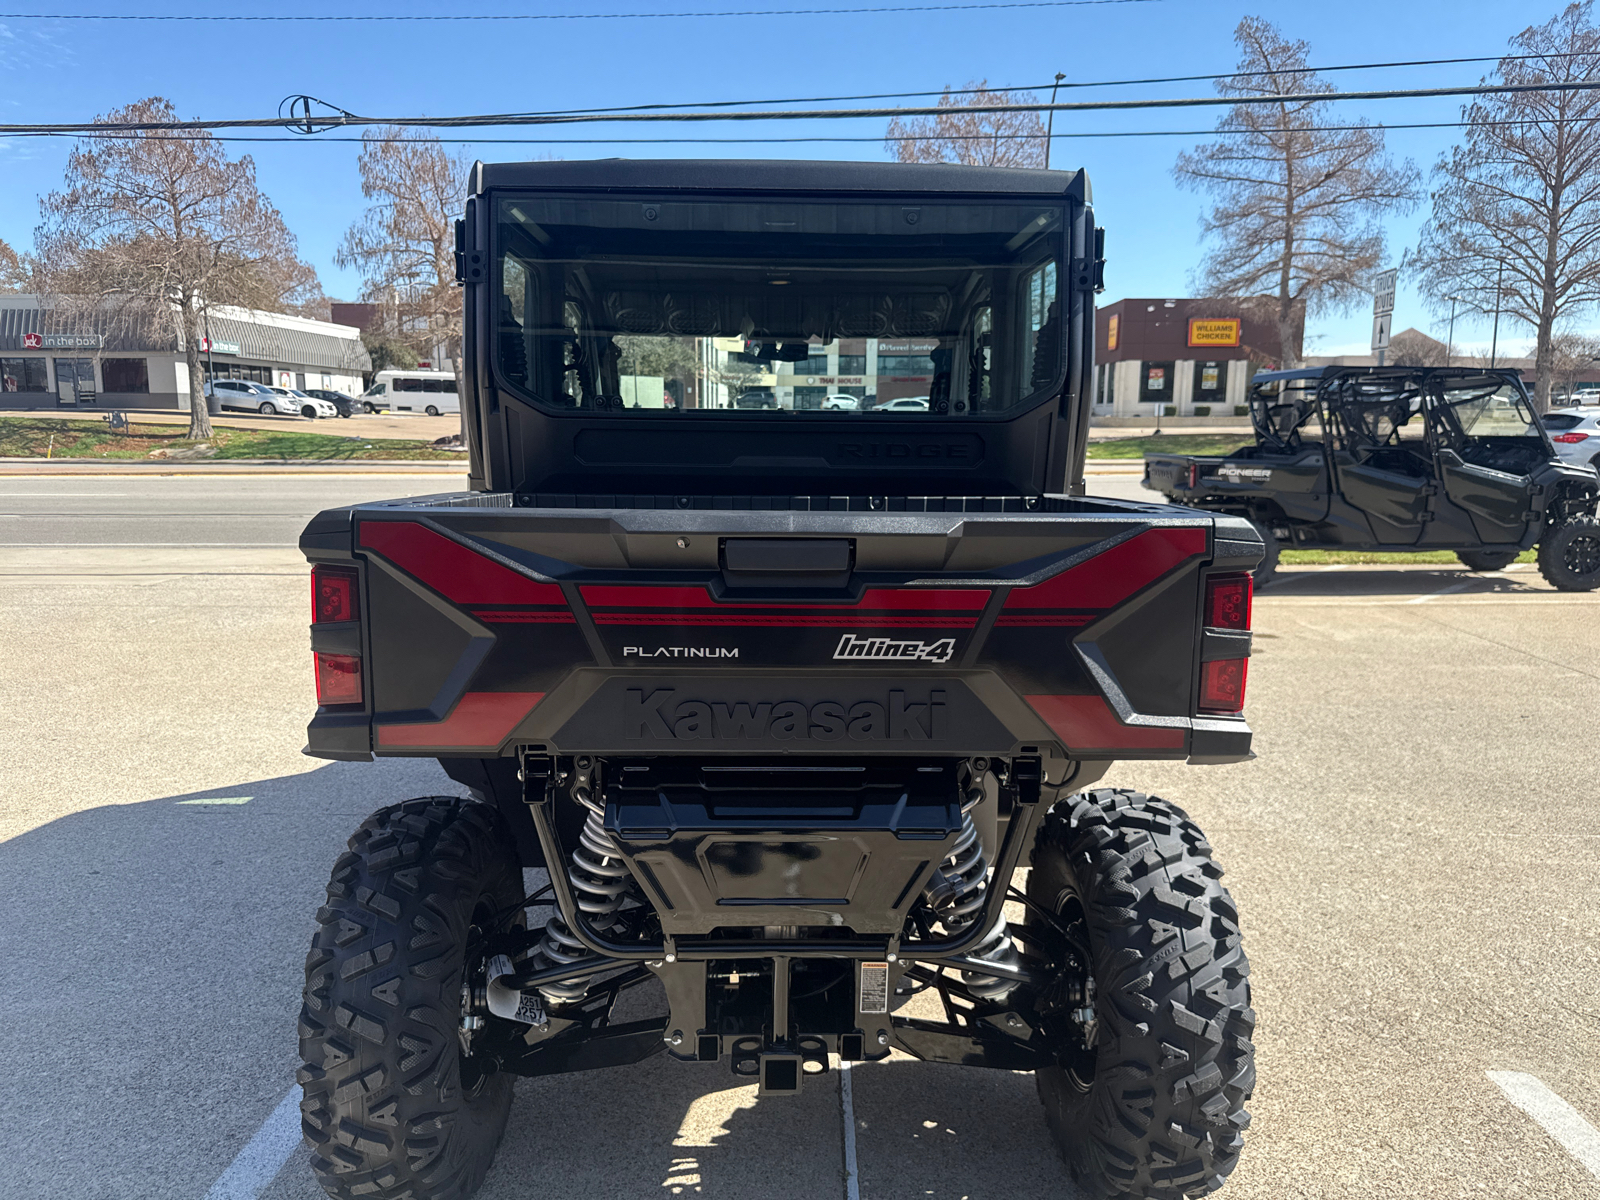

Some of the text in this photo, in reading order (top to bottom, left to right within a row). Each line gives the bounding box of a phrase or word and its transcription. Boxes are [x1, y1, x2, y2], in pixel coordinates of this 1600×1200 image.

[1376, 274, 1395, 292] TRUCK
[1375, 292, 1393, 310] ROUTE
[45, 337, 55, 346] in
[57, 337, 74, 346] the
[76, 337, 96, 346] box
[838, 442, 968, 458] RIDGE
[1218, 468, 1272, 477] PIONEER
[623, 634, 956, 663] PLATINUM Inline-4
[625, 688, 947, 742] Kawasaki
